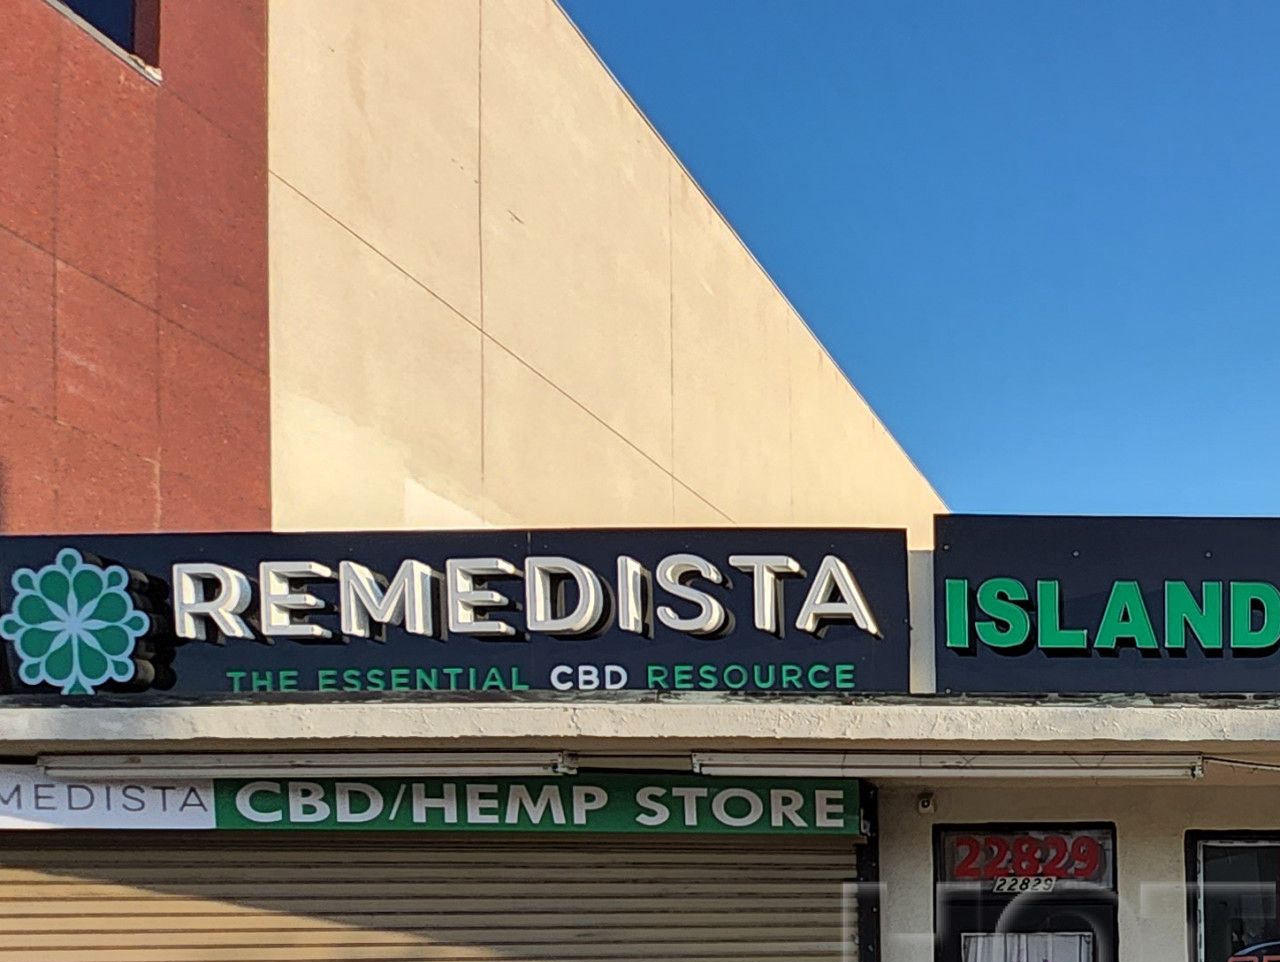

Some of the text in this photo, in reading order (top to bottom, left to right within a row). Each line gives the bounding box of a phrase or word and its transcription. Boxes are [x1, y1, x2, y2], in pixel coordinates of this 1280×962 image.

[171, 554, 884, 641] REMEDISTA
[227, 664, 855, 692] THE ESSENTIAL CBD RESOURCE
[235, 781, 608, 824] CBD/HEMP
[635, 786, 845, 827] STORE
[955, 835, 1099, 879] 22829
[996, 878, 1053, 892] 22829
